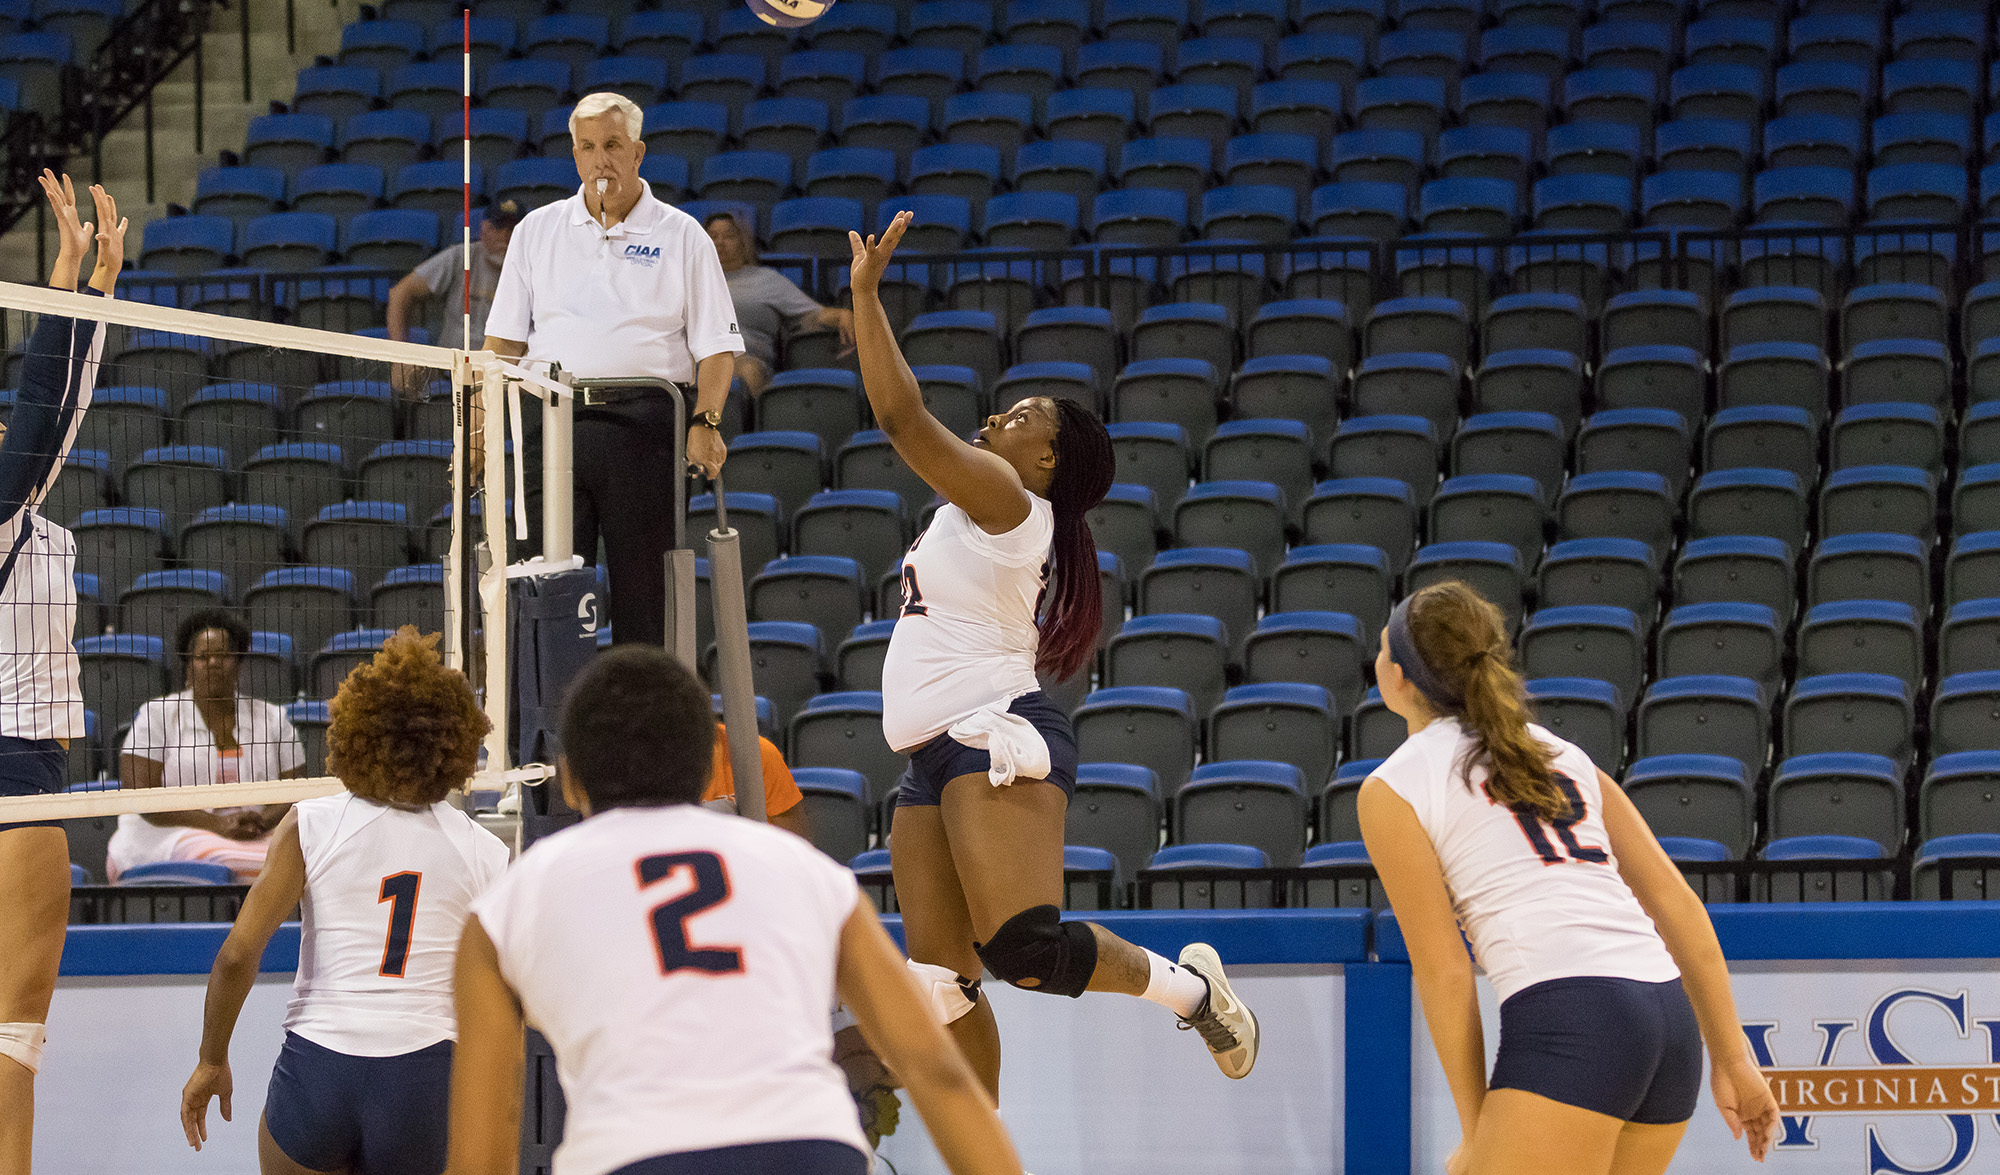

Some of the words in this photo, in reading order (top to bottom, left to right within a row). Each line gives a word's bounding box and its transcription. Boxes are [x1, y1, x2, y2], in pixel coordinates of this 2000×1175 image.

[624, 244, 661, 258] CIAA
[378, 869, 422, 978] 1
[632, 849, 746, 978] 2
